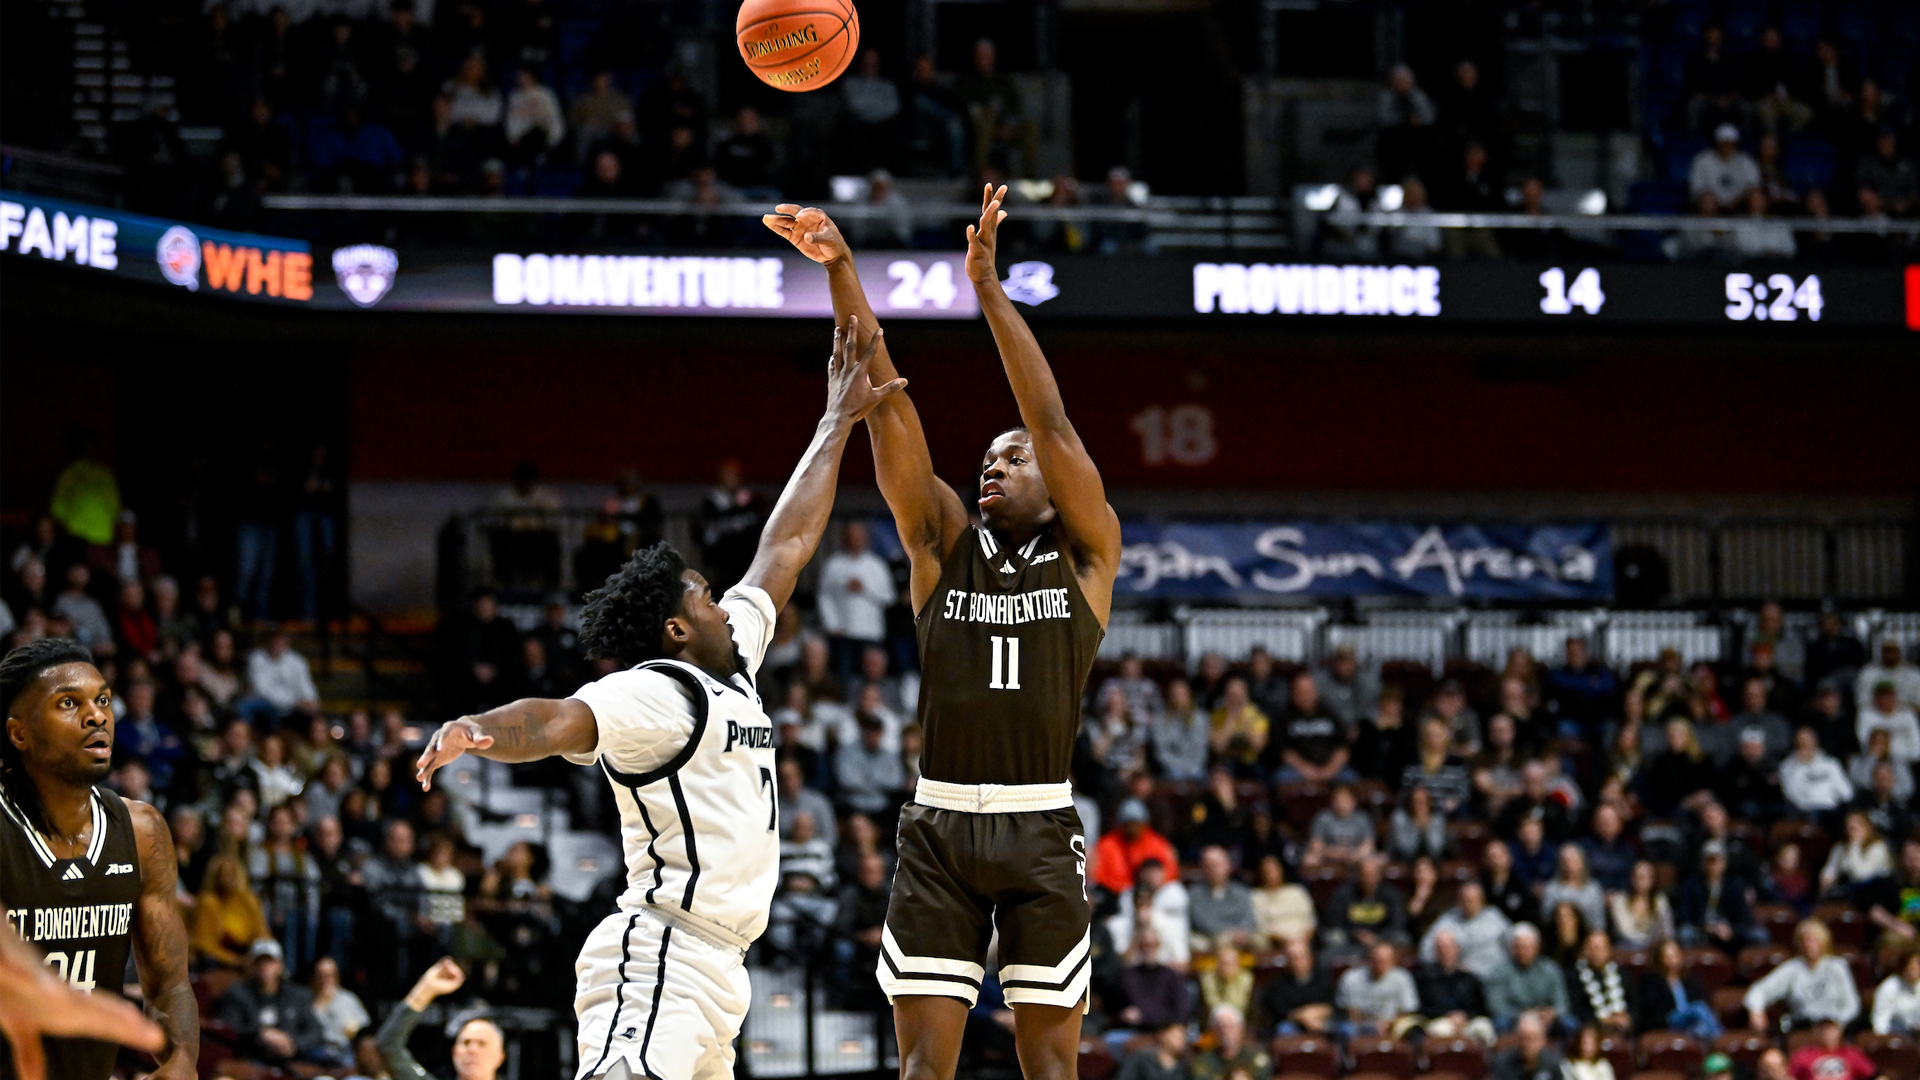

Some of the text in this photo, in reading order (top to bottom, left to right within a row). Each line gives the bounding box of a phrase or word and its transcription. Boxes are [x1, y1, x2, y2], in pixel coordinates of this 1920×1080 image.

[743, 23, 818, 60] SPALDING
[0, 202, 118, 270] FAME
[203, 240, 313, 301] WHE
[492, 253, 956, 310] BONAVENTURE 24
[1193, 263, 1824, 322] PROVIDENCE 14 5:24
[1130, 405, 1217, 467] 18
[1117, 525, 1597, 597] gan Sun Arena
[943, 587, 1071, 626] ST. BONAVENTURE
[989, 635, 1021, 690] 11
[758, 765, 777, 832] 7
[105, 863, 134, 876] A10
[33, 902, 133, 941] BONAVENTURE
